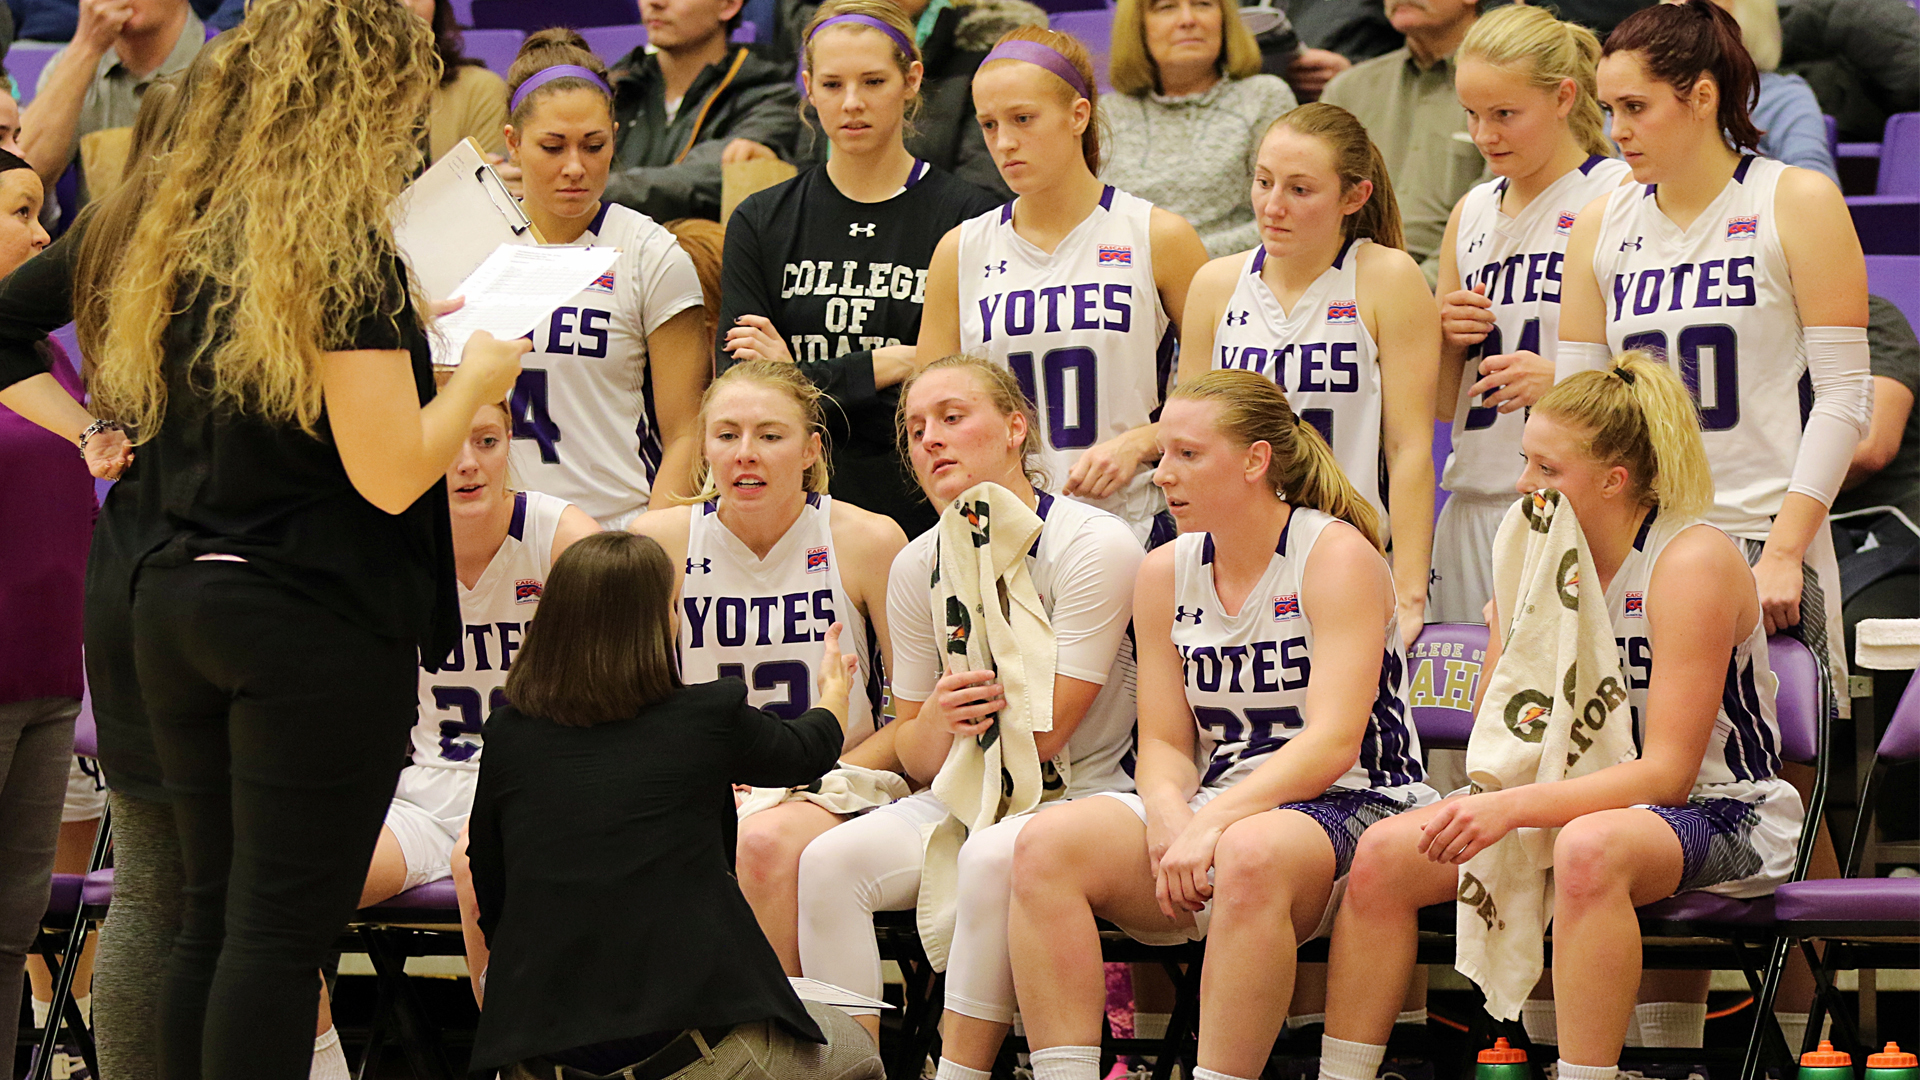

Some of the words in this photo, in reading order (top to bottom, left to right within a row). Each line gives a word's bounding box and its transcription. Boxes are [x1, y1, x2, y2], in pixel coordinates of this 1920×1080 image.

[825, 297, 876, 335] OF
[978, 283, 1133, 344] YOTES
[1613, 255, 1757, 323] YOTES
[509, 368, 562, 464] 4
[684, 588, 837, 649] YOTES
